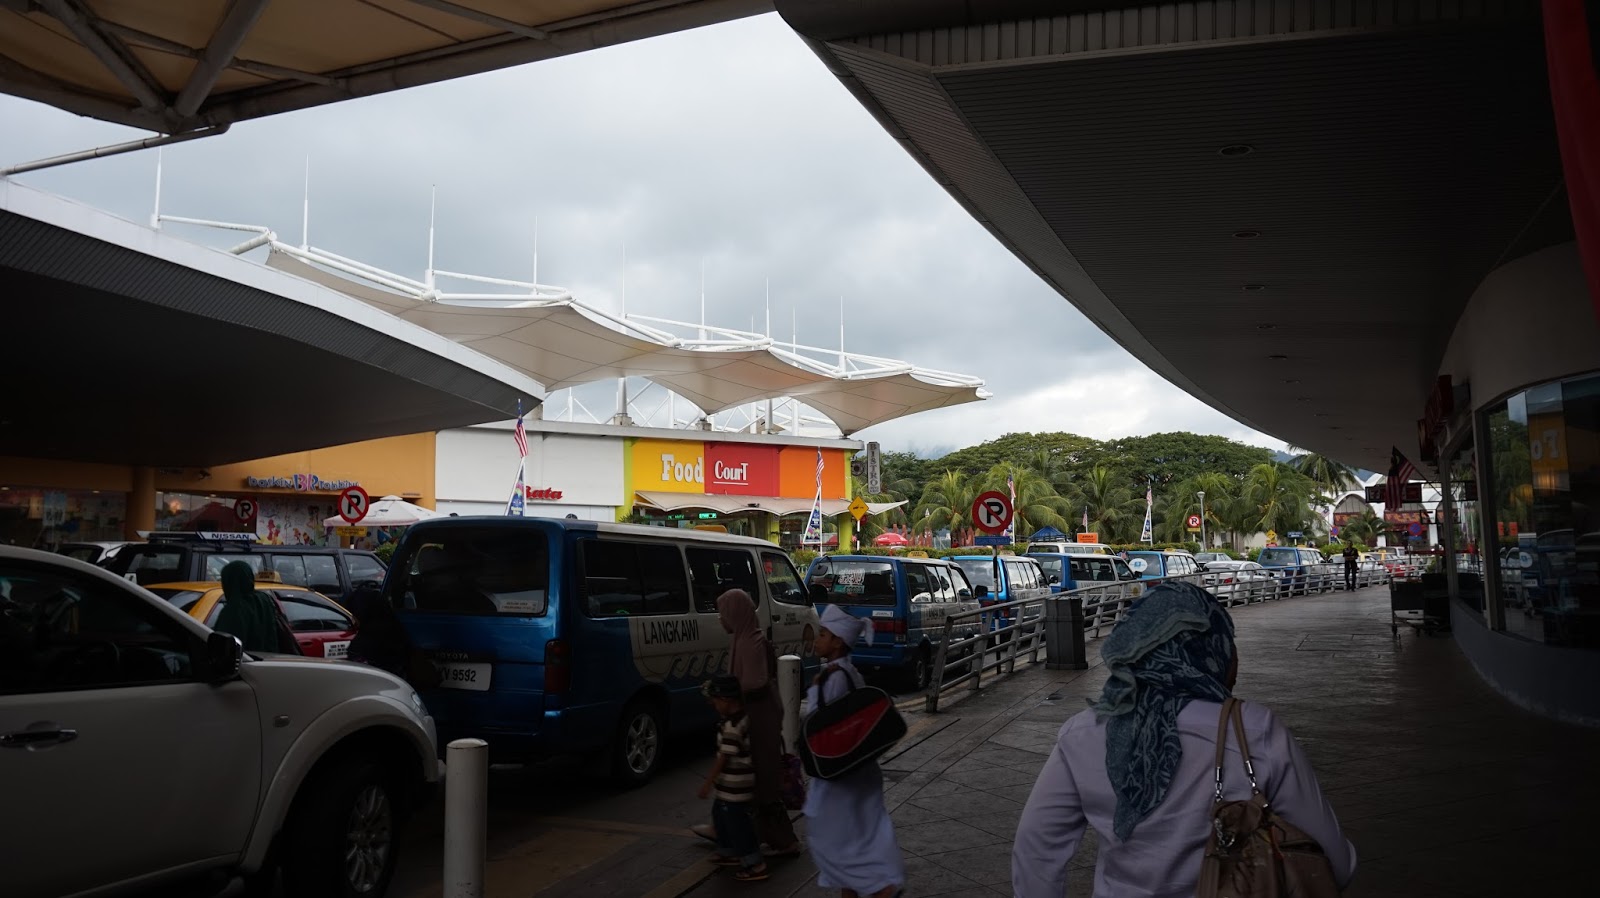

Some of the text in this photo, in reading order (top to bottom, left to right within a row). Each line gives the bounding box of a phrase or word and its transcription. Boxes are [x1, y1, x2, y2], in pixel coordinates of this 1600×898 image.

[661, 453, 704, 483] Food
[870, 443, 878, 486] BISTRO
[211, 533, 250, 541] NISSAN
[642, 619, 699, 645] LANGKAWI
[434, 651, 469, 661] TOYOTA
[452, 668, 477, 683] 9592
